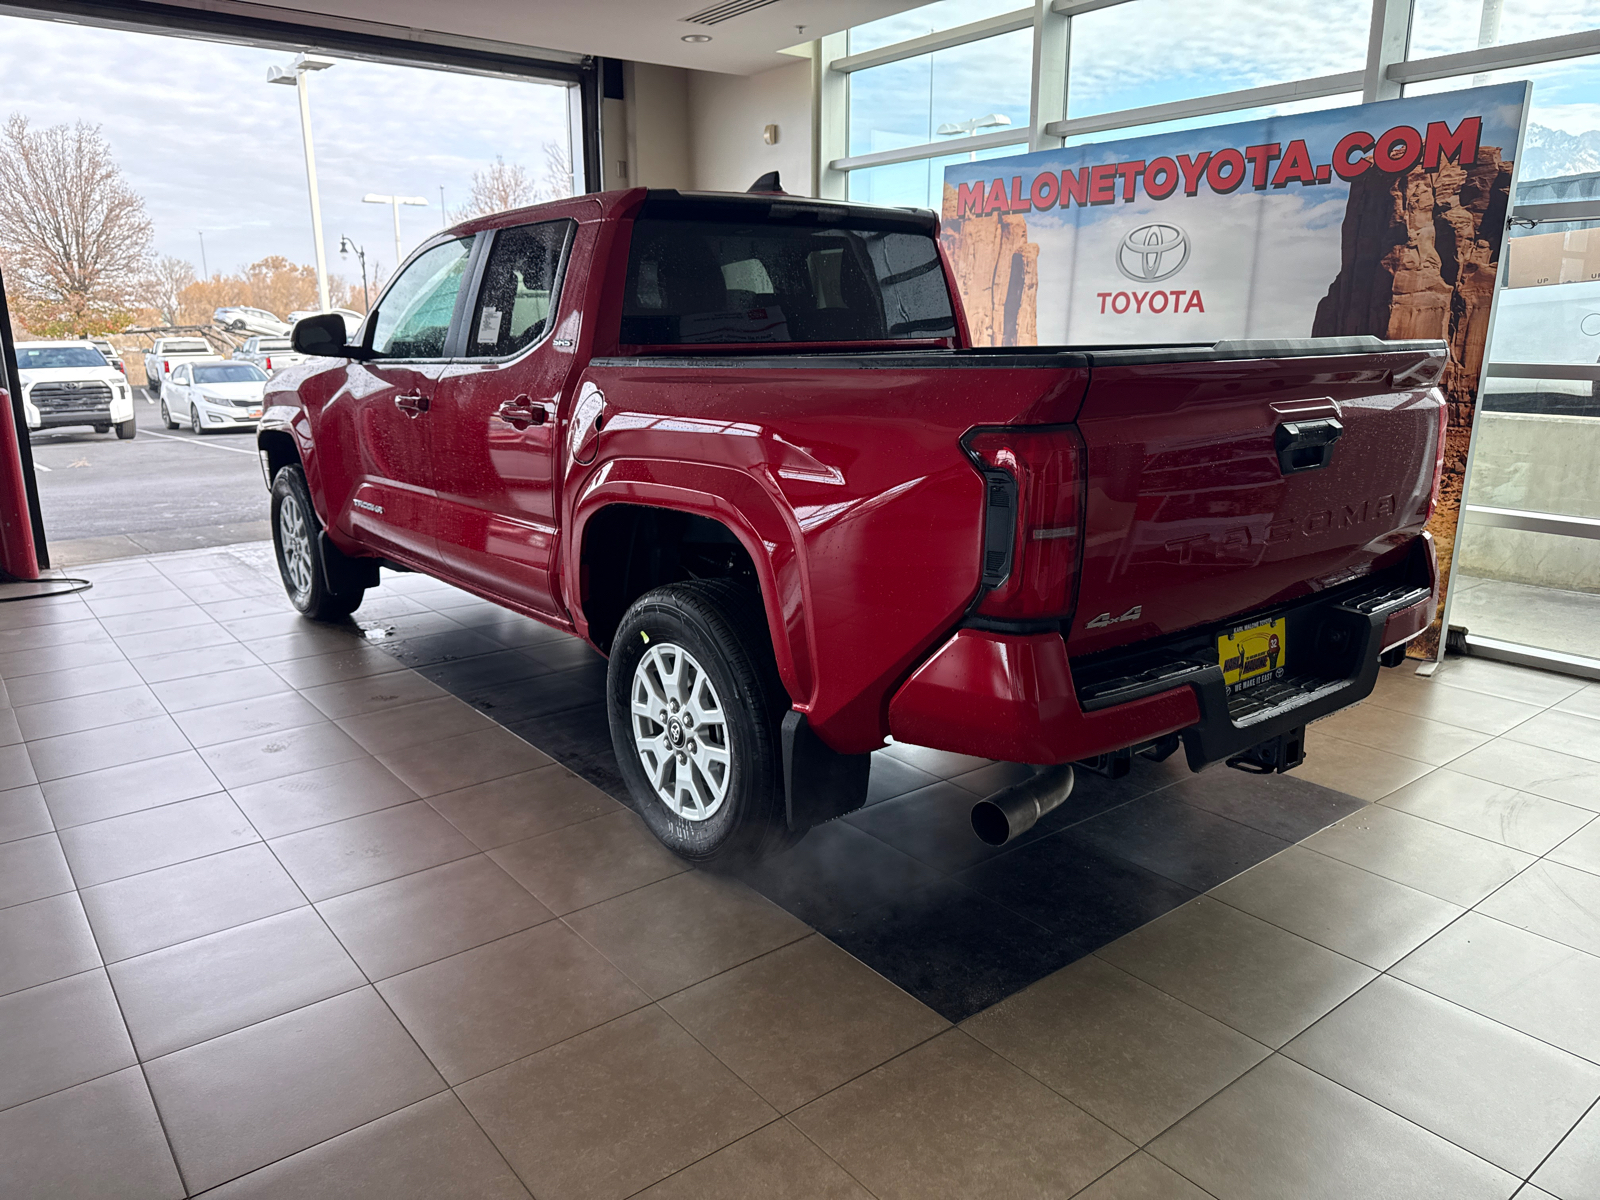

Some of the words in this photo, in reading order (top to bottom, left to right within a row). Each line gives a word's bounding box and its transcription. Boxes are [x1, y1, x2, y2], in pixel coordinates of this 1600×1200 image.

[957, 116, 1483, 217] MALONETOYOTA.COM
[1096, 290, 1206, 315] TOYOTA
[1164, 493, 1396, 565] TACOMA
[1270, 638, 1278, 648] 32
[1234, 683, 1242, 692] WE
[1243, 678, 1256, 689] MAKE
[1261, 672, 1273, 682] EASY
